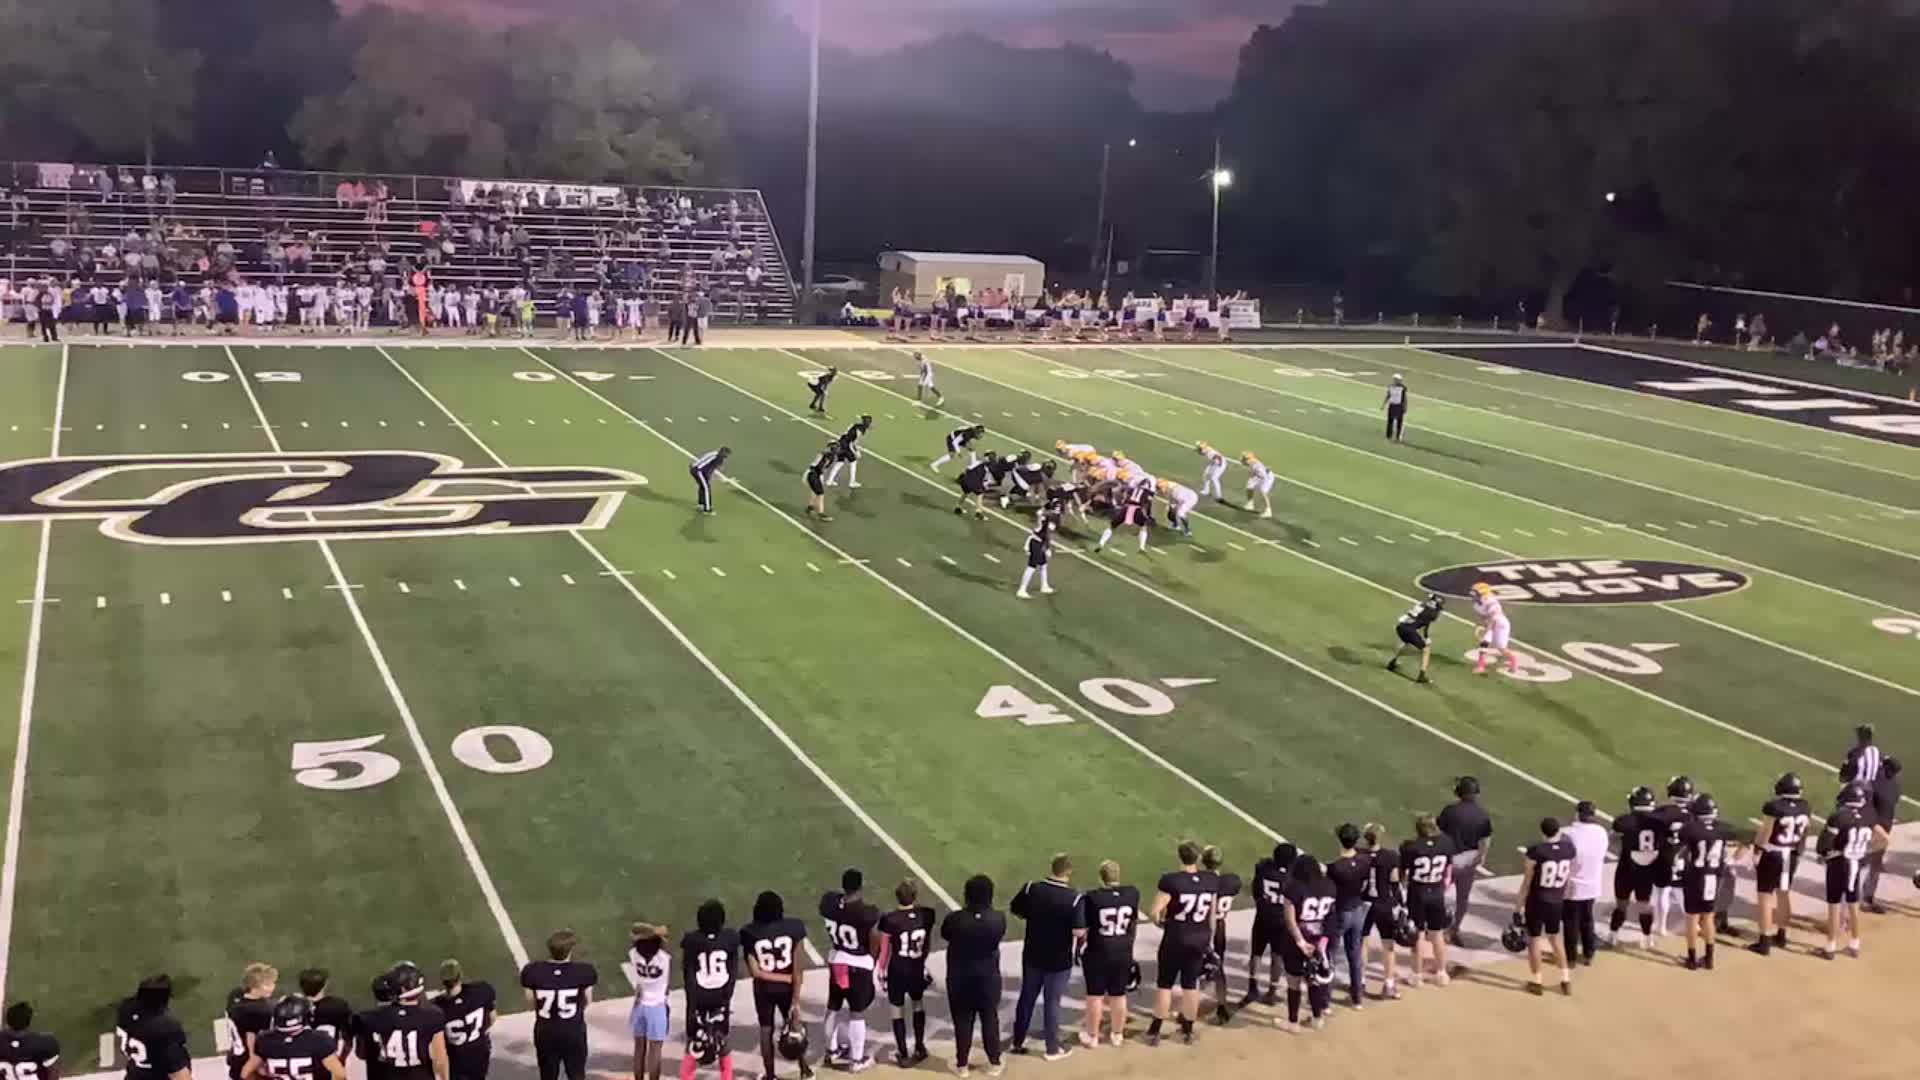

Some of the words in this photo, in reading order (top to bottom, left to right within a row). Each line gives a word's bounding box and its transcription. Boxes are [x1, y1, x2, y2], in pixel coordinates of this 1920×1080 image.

[1477, 560, 1638, 580] THE
[1484, 572, 1739, 600] GROVE
[975, 677, 1175, 726] 40
[291, 725, 553, 790] 50
[1694, 839, 1723, 869] 14
[1412, 855, 1448, 884] 22
[1262, 879, 1285, 905] 5
[1099, 905, 1133, 936] 56
[754, 935, 793, 972] 63
[899, 929, 926, 959] 13
[697, 949, 728, 978] 16
[535, 989, 579, 1019] 75
[386, 1029, 421, 1067] 41
